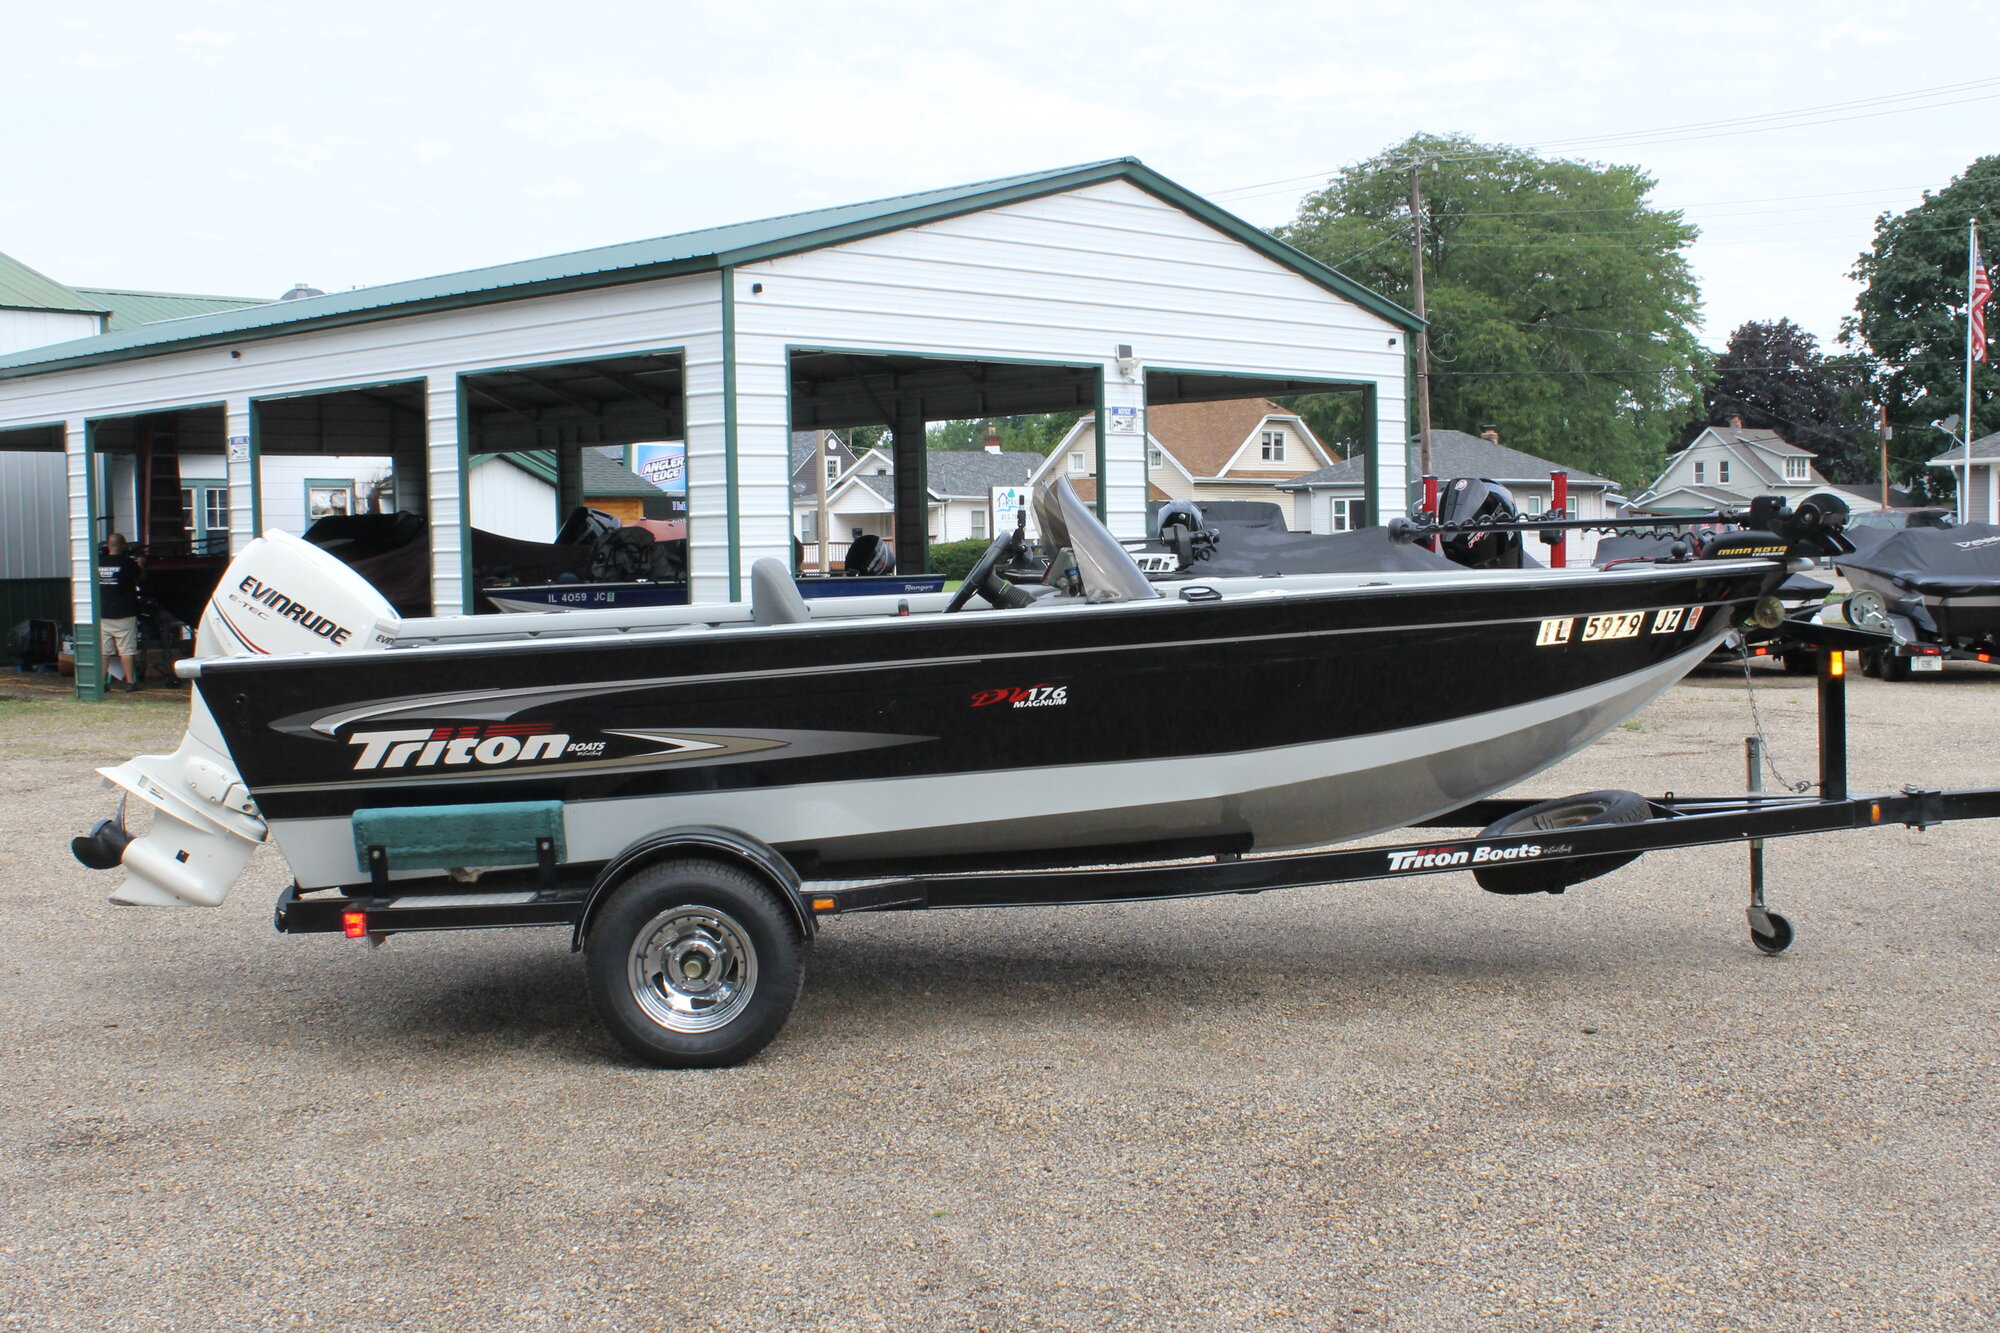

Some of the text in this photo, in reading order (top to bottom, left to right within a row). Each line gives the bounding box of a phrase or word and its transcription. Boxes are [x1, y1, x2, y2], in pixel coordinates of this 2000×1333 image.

[643, 456, 686, 474] ANGLER
[653, 468, 680, 482] EDGE
[1717, 546, 1788, 556] MINN KOTA
[904, 584, 935, 592] Ranger
[548, 592, 606, 603] IL 4059 JC
[229, 594, 270, 621] E-TEC
[239, 575, 353, 647] EVINRUDE
[1542, 610, 1682, 643] IL 5979 JZ
[376, 633, 395, 646] EVIN
[1013, 698, 1068, 708] MAGNUM
[348, 728, 607, 771] Triton BOATS
[1387, 849, 1470, 872] Triton
[1472, 843, 1543, 863] Boats
